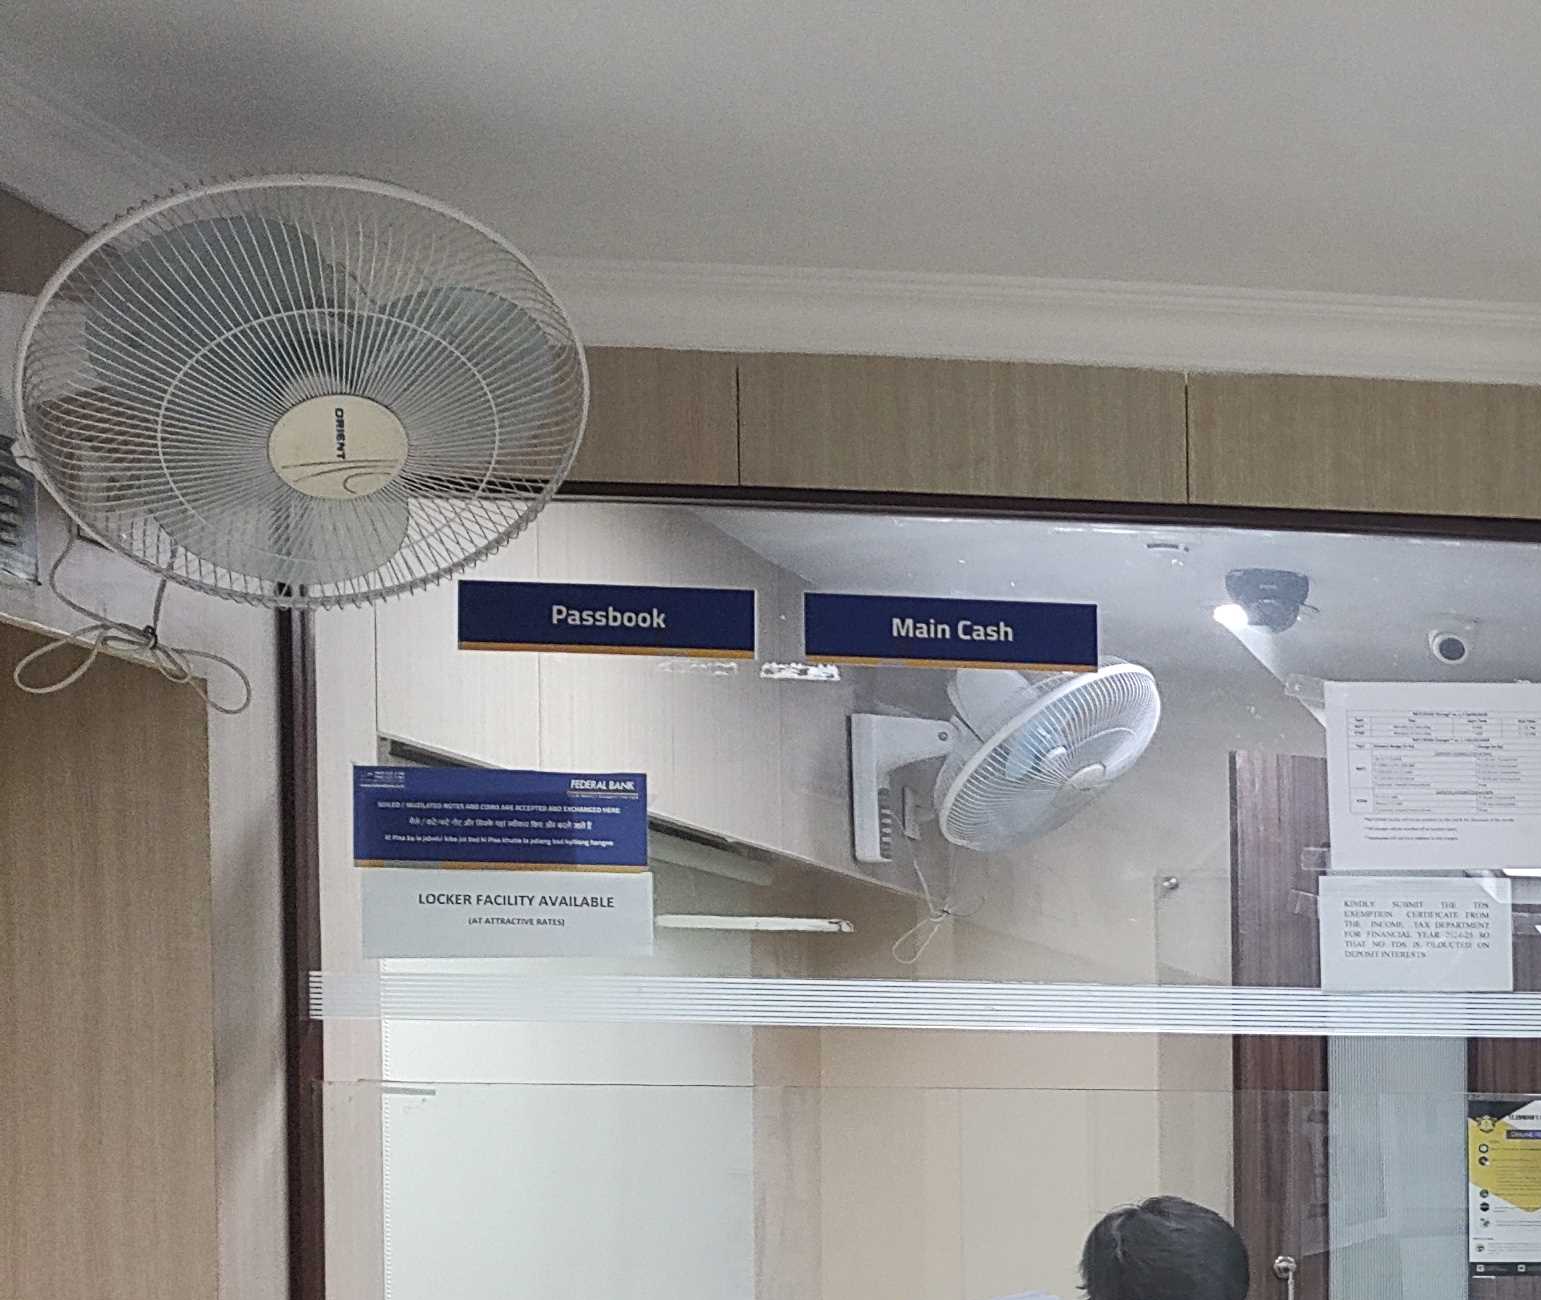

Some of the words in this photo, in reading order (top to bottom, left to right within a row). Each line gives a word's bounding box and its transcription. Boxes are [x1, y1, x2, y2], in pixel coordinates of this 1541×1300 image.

[335, 407, 346, 459] ORIENT
[551, 604, 666, 629] Passbook
[892, 617, 951, 641] Main
[957, 619, 1014, 643] Cash
[570, 780, 607, 790] FEDERAL
[608, 781, 635, 791] BANK
[418, 893, 472, 906] LOCKER
[476, 894, 534, 907] FACILITY
[538, 895, 615, 908] AVAILABLE
[484, 917, 535, 927] ATTRACTIVE
[1435, 922, 1489, 930] DEPARTMENT
